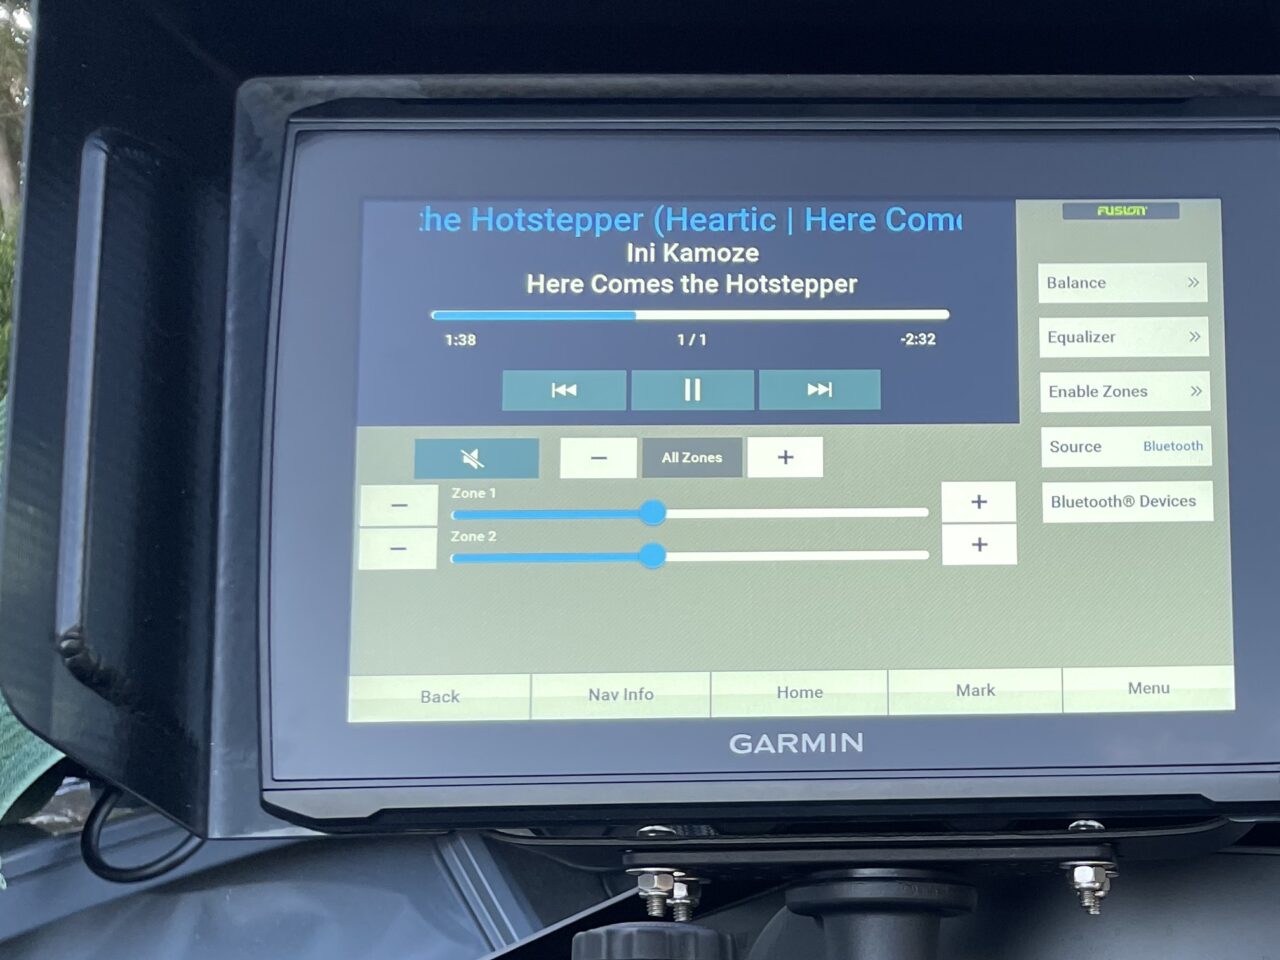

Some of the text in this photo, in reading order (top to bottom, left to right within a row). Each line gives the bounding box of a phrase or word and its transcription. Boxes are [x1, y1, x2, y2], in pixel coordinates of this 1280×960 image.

[419, 206, 461, 231] he
[472, 206, 644, 237] Hotstepper
[654, 205, 776, 238] (Heartic
[805, 206, 876, 232] Here
[627, 242, 760, 263] Ini Kamoze
[527, 273, 858, 298] Here Comes the Hotstepper
[1047, 276, 1106, 289] Balance
[445, 333, 477, 346] 1:38
[900, 333, 936, 346] -2:32
[1048, 330, 1116, 346] Equalizer
[1049, 384, 1148, 398] Enable Zones
[1050, 440, 1102, 453] Source
[1143, 440, 1204, 453] Bluetooth
[662, 451, 723, 464] All Zones
[451, 488, 496, 499] Zone 1
[1140, 494, 1196, 508] Devices
[451, 531, 497, 542] Zone 2
[589, 687, 654, 701] Nav Info
[777, 686, 824, 699] Home
[956, 683, 996, 697] Mark
[1128, 681, 1170, 695] Menu
[420, 689, 461, 704] Back
[729, 732, 864, 754] GARMIN
